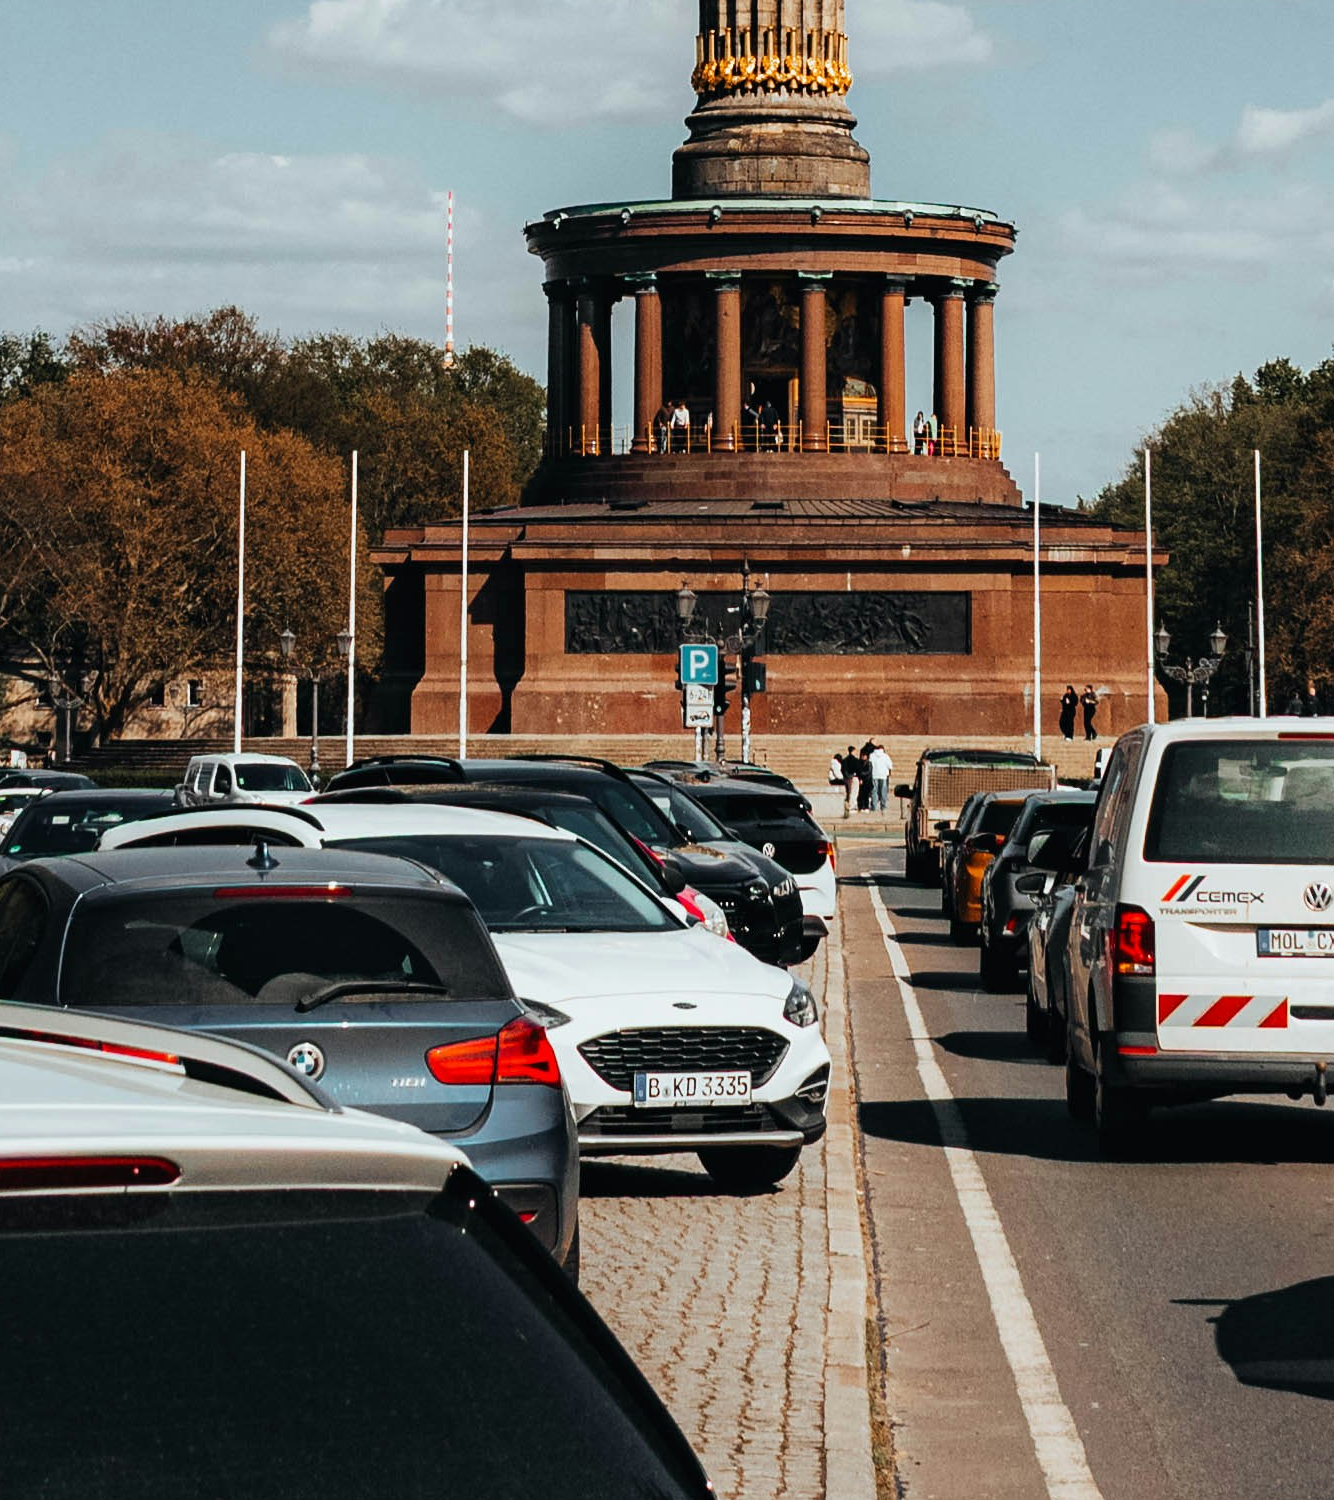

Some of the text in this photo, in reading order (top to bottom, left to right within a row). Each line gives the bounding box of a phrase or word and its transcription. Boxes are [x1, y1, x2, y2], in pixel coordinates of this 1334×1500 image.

[690, 650, 709, 679] P
[1196, 891, 1264, 903] CEMEX
[1271, 932, 1304, 950] MOL
[649, 1076, 747, 1097] B KD 3335
